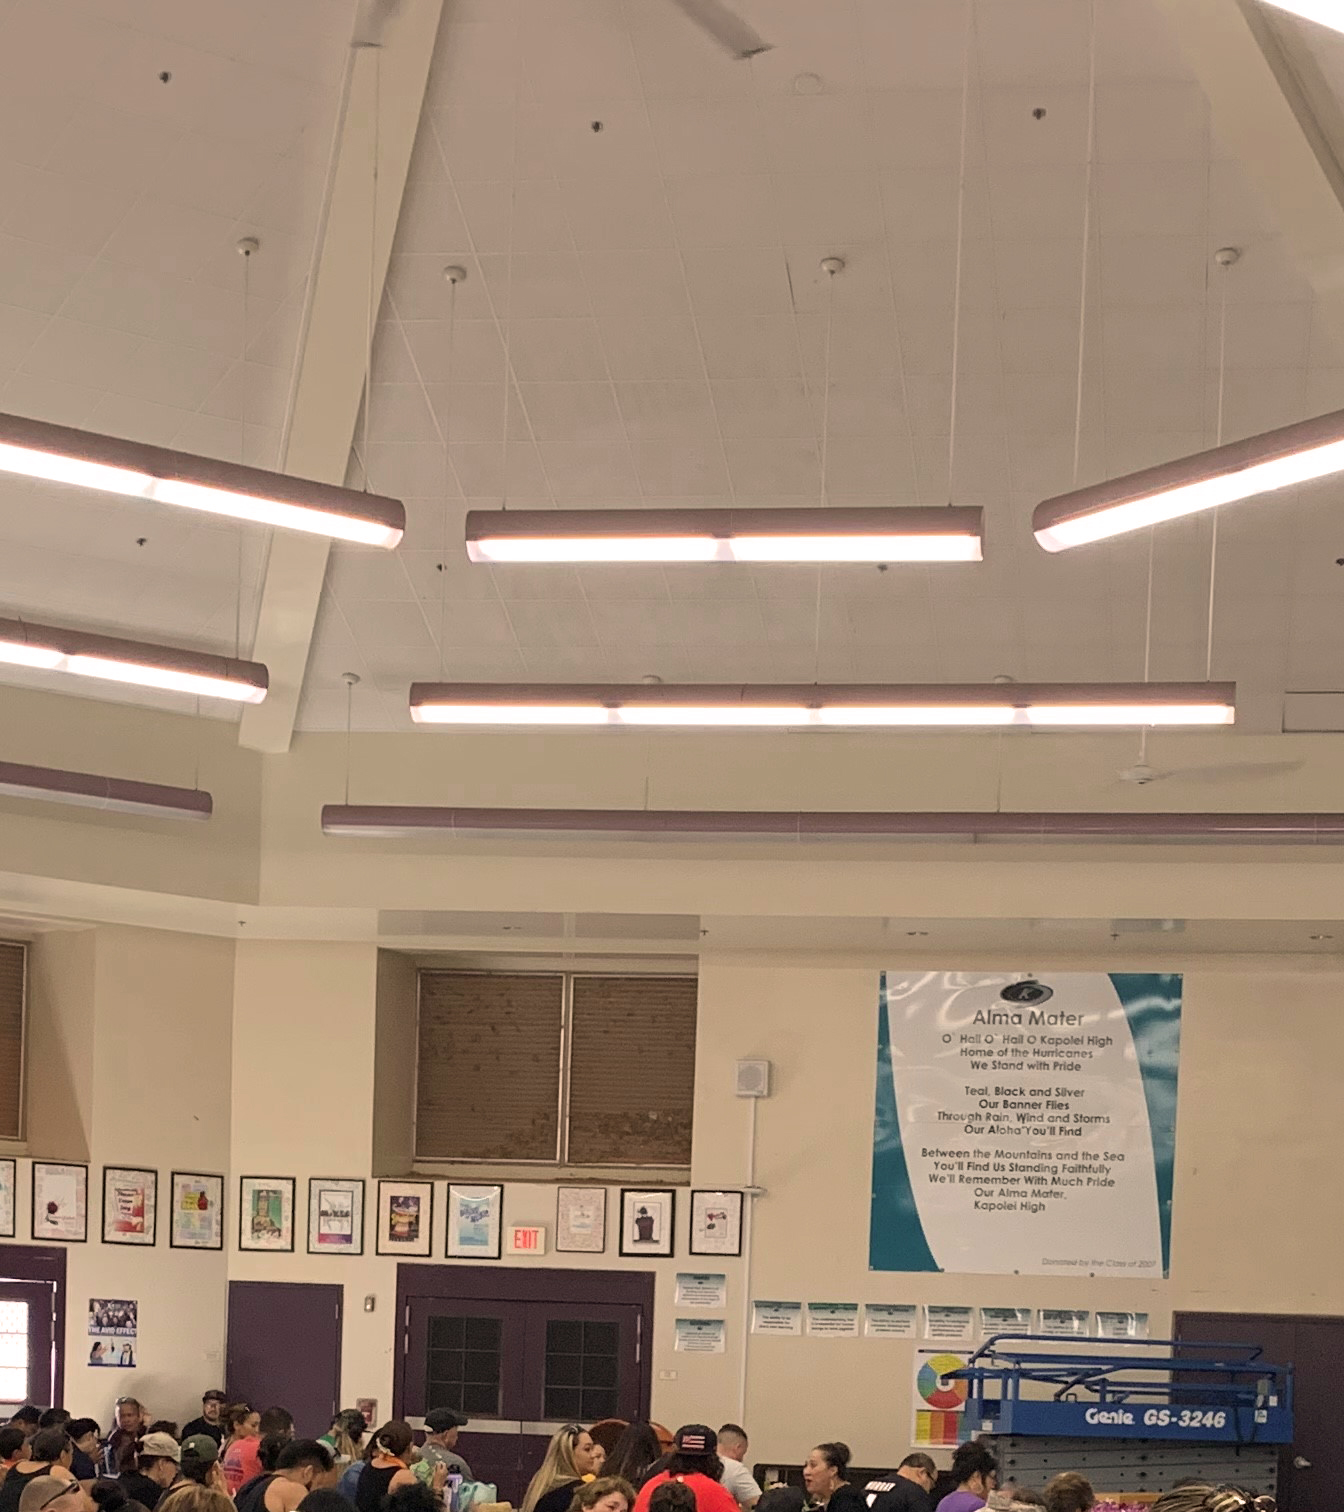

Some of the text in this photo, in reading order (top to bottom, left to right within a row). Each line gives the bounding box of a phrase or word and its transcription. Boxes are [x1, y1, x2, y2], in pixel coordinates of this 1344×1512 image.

[972, 1009, 1085, 1026] Alma Mater
[1087, 1036, 1113, 1048] High
[959, 1048, 1094, 1059] Home of the Hurricanes
[970, 1060, 1082, 1071] We Stand with Pride
[994, 1086, 1026, 1097] Black
[1029, 1087, 1052, 1097] and
[1054, 1087, 1085, 1098] Silver
[978, 1099, 1070, 1110] Our Banner Flies
[937, 1111, 982, 1123] Through
[1016, 1112, 1044, 1123] Wind
[1047, 1113, 1070, 1123] and
[1073, 1113, 1110, 1124] Storms
[964, 1124, 985, 1135] Our
[987, 1125, 1022, 1135] Aloha
[1059, 1126, 1082, 1136] Find
[921, 1148, 1125, 1162] Between the Mountains and the Sea
[967, 1161, 990, 1172] Find
[993, 1162, 1006, 1172] Us
[1008, 1162, 1058, 1175] Standing
[1061, 1163, 1112, 1176] Faithfully
[958, 1174, 1021, 1185] Remember
[1051, 1176, 1083, 1186] Much
[1086, 1177, 1115, 1188] Pride
[974, 1188, 994, 1198] Our
[997, 1188, 1028, 1198] Alma
[1020, 1201, 1046, 1213] High
[514, 1229, 539, 1249] EXIT
[1085, 1408, 1226, 1428] Genie GS-3246
